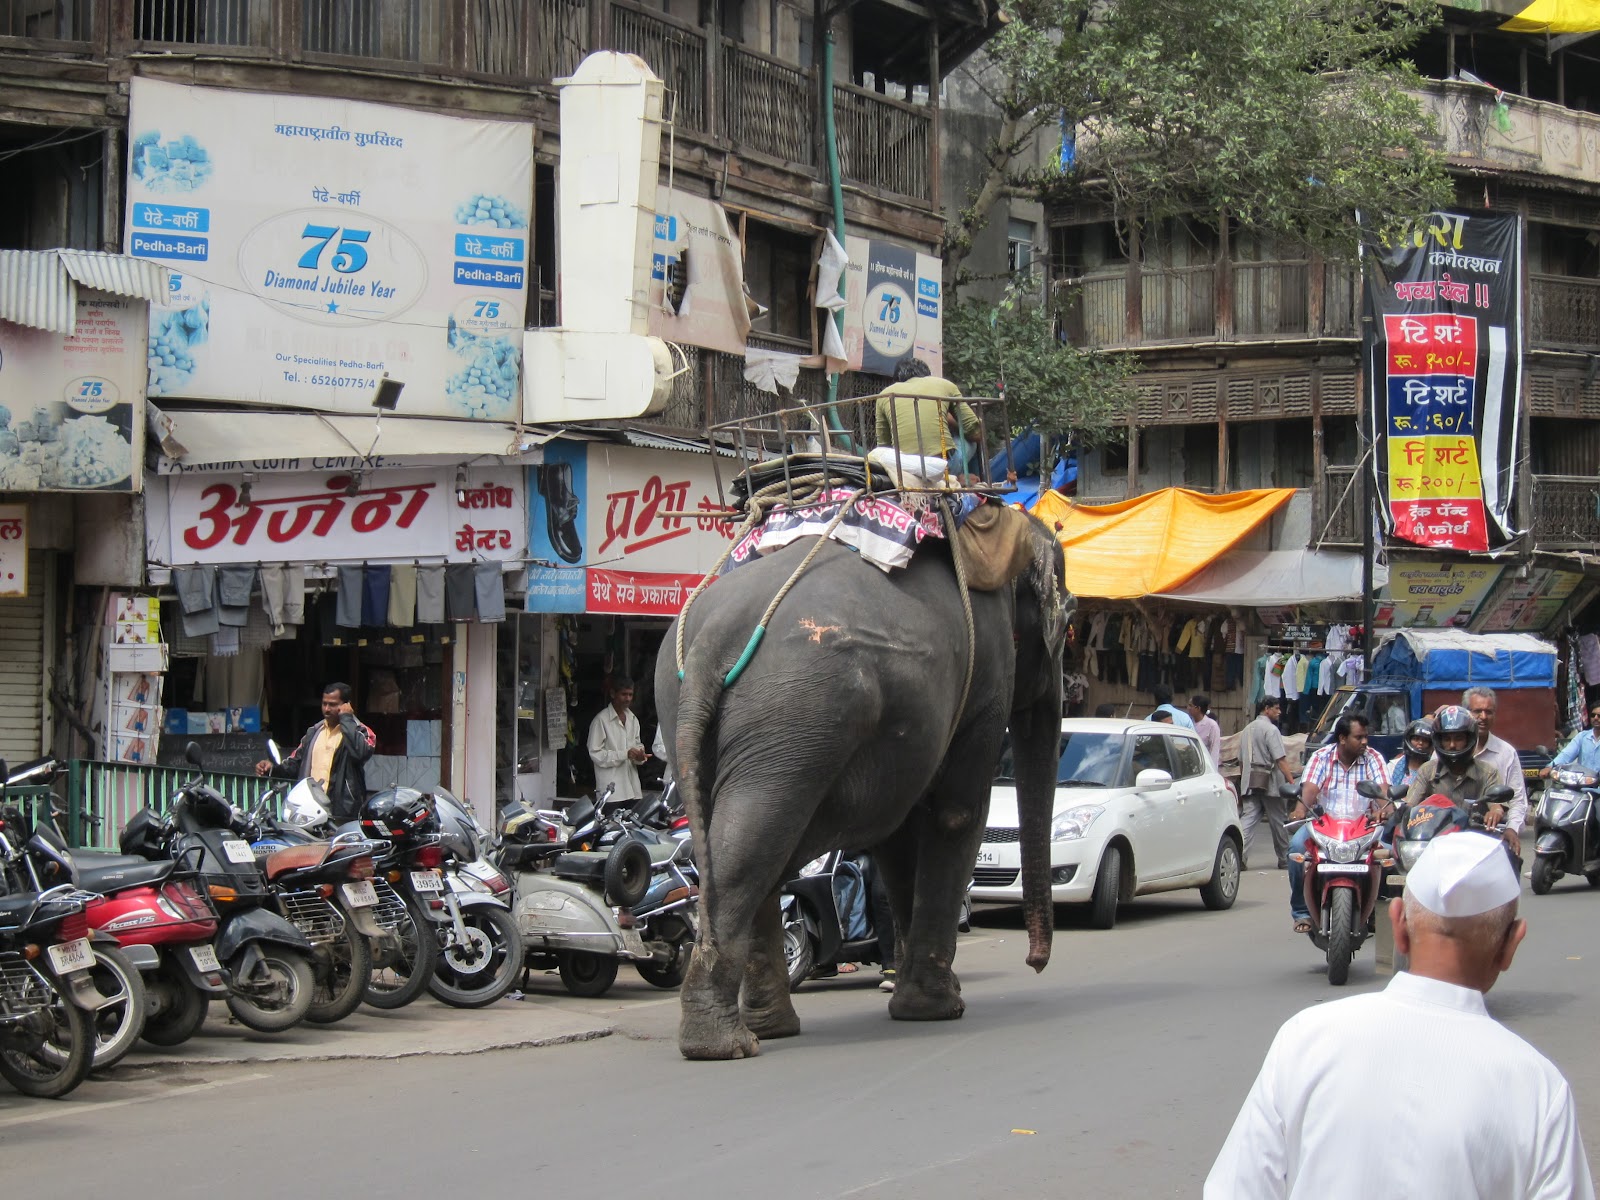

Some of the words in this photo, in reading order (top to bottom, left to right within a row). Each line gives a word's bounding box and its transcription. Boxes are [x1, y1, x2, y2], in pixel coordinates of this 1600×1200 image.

[274, 123, 351, 141] महाराष्ट्रातील
[134, 239, 206, 254] Pedha-Barfi
[297, 222, 371, 273] 75
[1429, 247, 1502, 273] कलेक्शन
[264, 270, 319, 292] Diamond
[321, 276, 366, 296] Jubilee
[370, 280, 396, 298] Year
[457, 268, 521, 283] Pedha-Barfi
[1394, 281, 1437, 301] भव्य
[474, 300, 500, 319] 75
[880, 292, 901, 324] 75
[1400, 319, 1428, 343] टि
[275, 353, 291, 362] Our
[293, 355, 337, 367] Specialities
[339, 360, 384, 370] Pedha-Barfi
[80, 381, 103, 396] 75
[284, 371, 300, 382] Tel.
[311, 375, 375, 389] 65260775/4
[1402, 379, 1430, 405] टि
[1432, 379, 1467, 405] शर्ट
[1433, 440, 1469, 466] शर्ट
[1428, 521, 1470, 535] फोर्थ
[455, 524, 512, 552] सेन्टर
[592, 574, 612, 602] येथे
[616, 577, 635, 603] सर्व
[640, 580, 682, 605] प्रकारची
[416, 880, 440, 889] 3954
[108, 918, 139, 930] Access
[139, 915, 156, 924] 125
